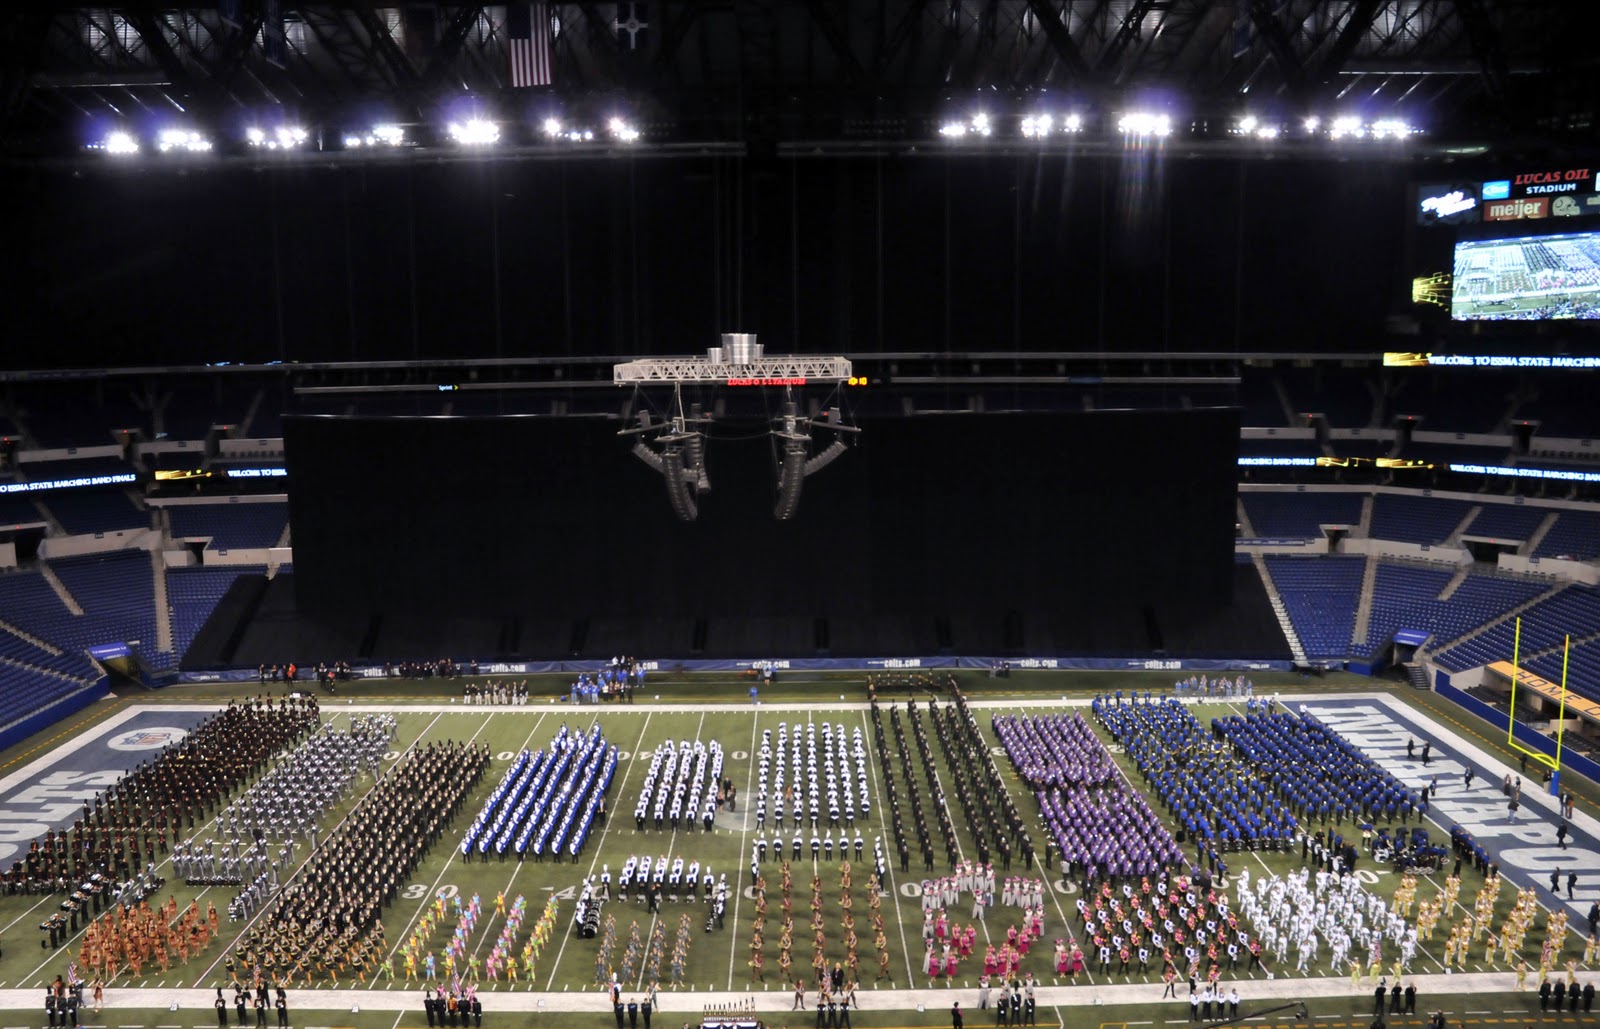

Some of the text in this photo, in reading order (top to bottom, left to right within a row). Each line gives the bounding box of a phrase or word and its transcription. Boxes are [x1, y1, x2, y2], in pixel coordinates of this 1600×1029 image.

[1515, 169, 1590, 185] LUCAS OIL
[1526, 183, 1577, 194] STADIUM
[1490, 201, 1542, 219] meijer
[1428, 356, 1474, 365] WELCOME
[1475, 356, 1490, 365] TO
[1519, 357, 1551, 367] STATE
[1449, 464, 1485, 473] WELCOME
[1486, 466, 1498, 474] TO
[29, 481, 53, 490] STATE
[54, 478, 91, 488] MARCHING
[92, 476, 111, 485] BAND
[112, 474, 136, 483] FINALS
[884, 659, 921, 668] colts.com
[1511, 671, 1582, 704] HOME
